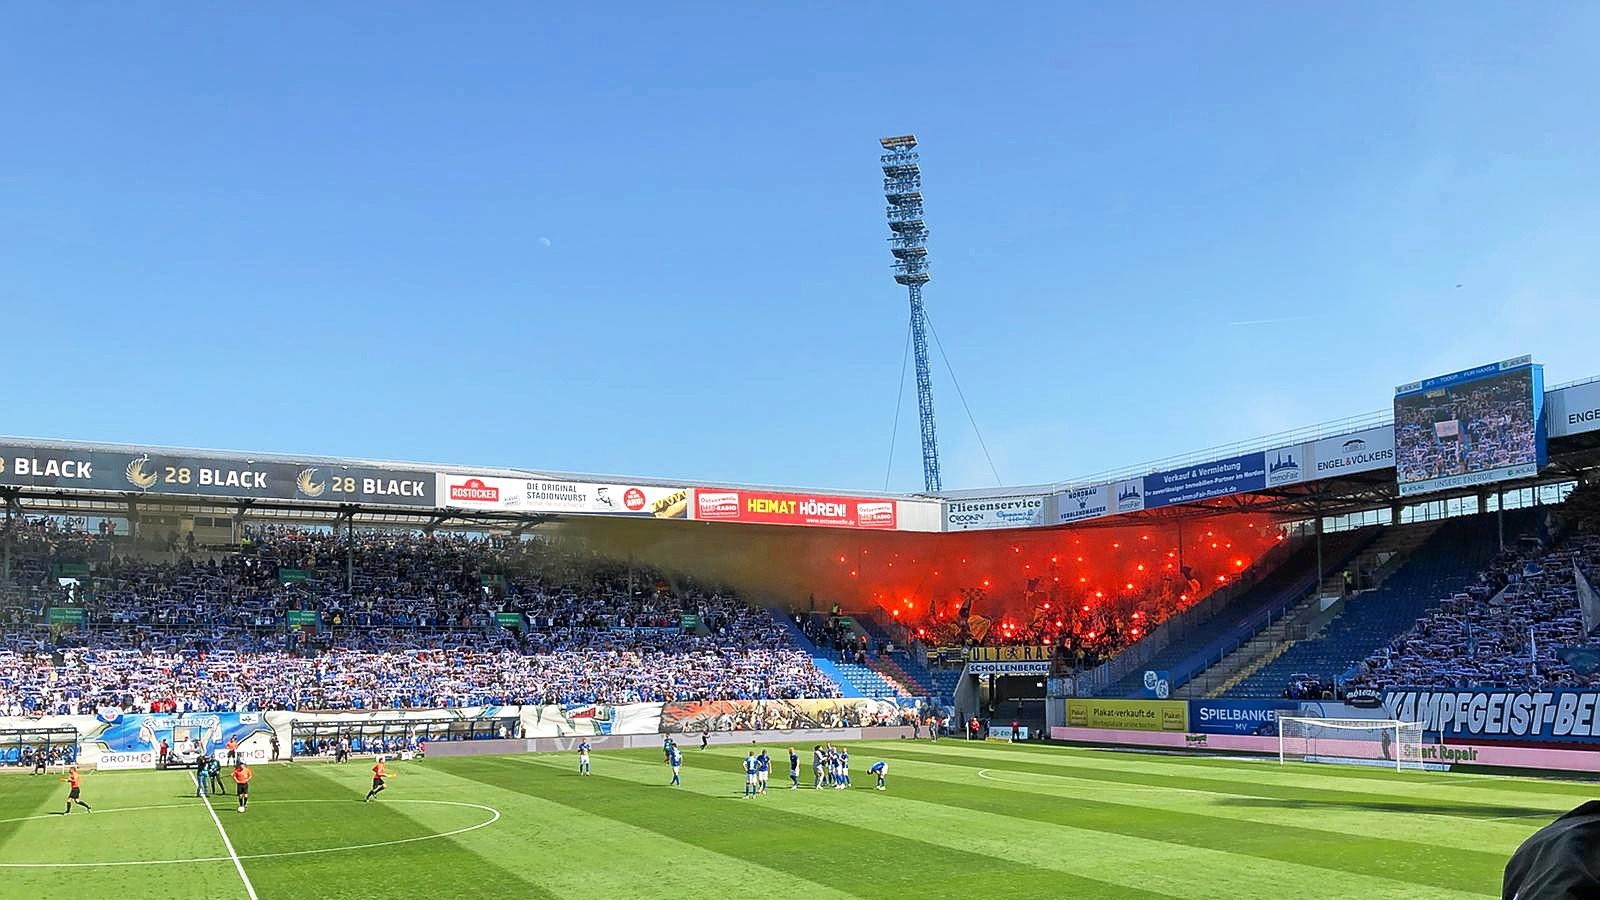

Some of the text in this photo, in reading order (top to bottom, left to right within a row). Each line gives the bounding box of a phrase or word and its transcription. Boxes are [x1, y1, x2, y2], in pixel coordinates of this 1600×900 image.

[1568, 409, 1600, 424] ENGE
[15, 457, 91, 479] BLACK
[1163, 462, 1241, 484] Verkauf & Vermietung
[165, 467, 267, 489] 28 BLACK
[332, 476, 425, 497] 28 BLACK
[452, 488, 497, 499] ROSTOCKER
[526, 482, 577, 493] DIE ORIGINAL
[1069, 488, 1097, 499] NORDBAU
[526, 491, 587, 502] STADIONWURST
[748, 498, 847, 517] HEIMAT HÖREN!
[949, 499, 1041, 513] Fliesenservice
[1093, 708, 1155, 719] Plakat-verkauft.de
[1235, 723, 1248, 731] MV
[101, 754, 139, 763] GROTH
[1439, 745, 1478, 763] Repair
